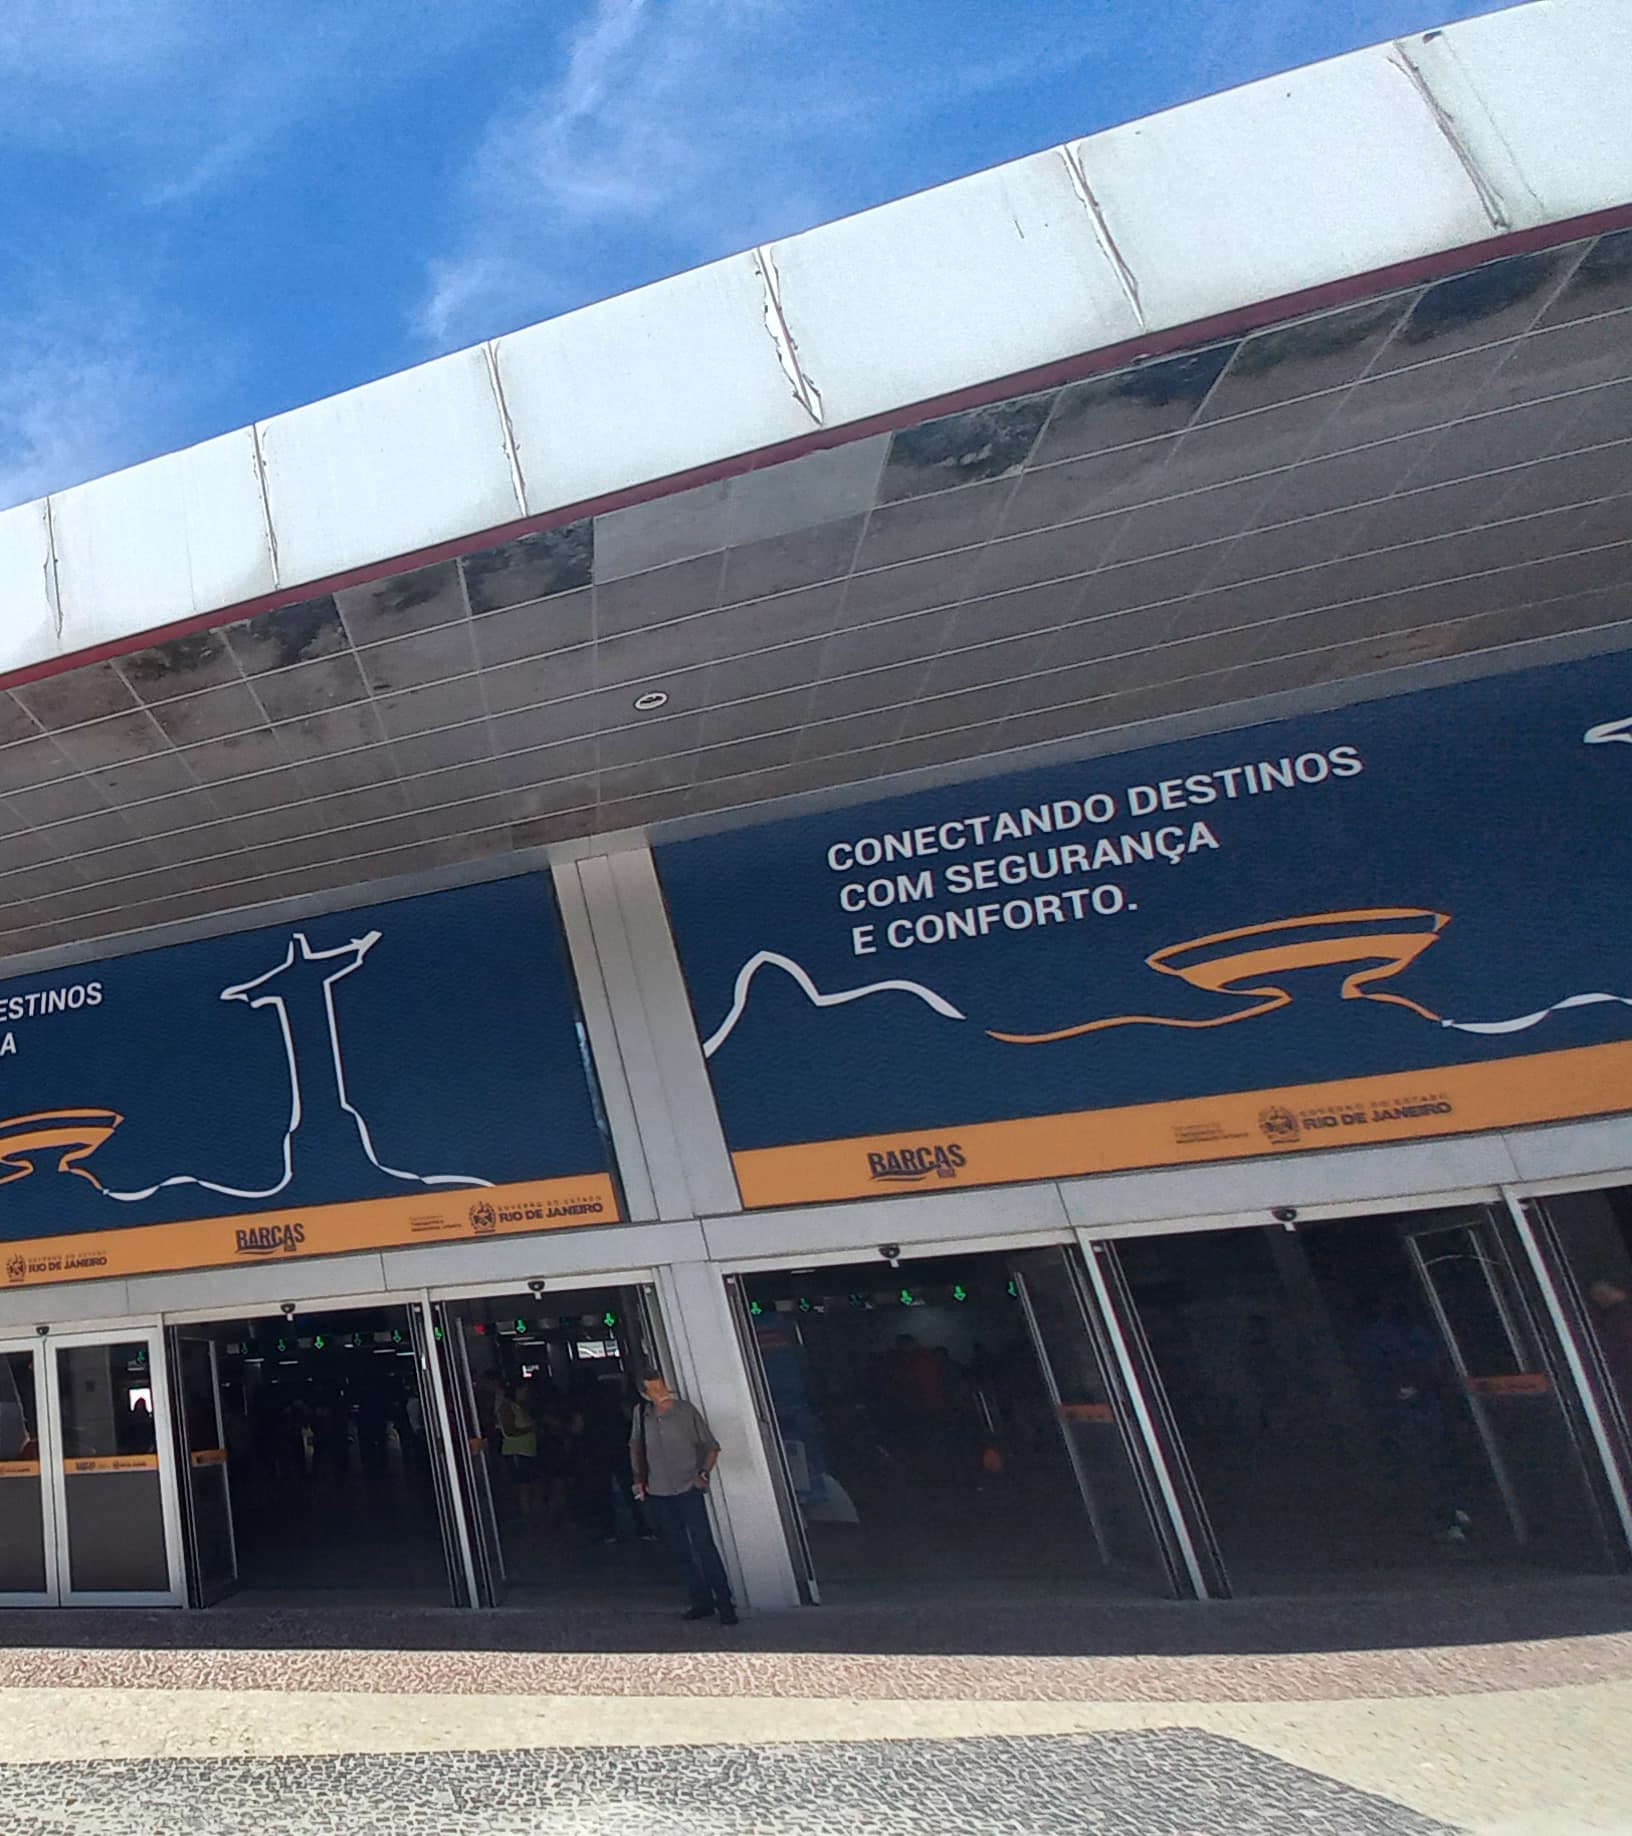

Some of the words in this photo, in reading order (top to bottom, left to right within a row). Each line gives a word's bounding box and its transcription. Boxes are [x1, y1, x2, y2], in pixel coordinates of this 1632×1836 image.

[827, 793, 1115, 871] CONECTANDO
[1126, 746, 1363, 817] DESTINOS
[839, 870, 934, 913] COM
[945, 821, 1218, 895] SEGURANÇA
[851, 925, 876, 955] E
[887, 883, 1138, 950] CONFORTO.
[1302, 1115, 1338, 1130] RIO
[1340, 1112, 1368, 1126] DE
[1371, 1101, 1452, 1122] JANEIRO
[867, 1144, 966, 1177] BARCAS
[498, 1211, 523, 1224] RIO
[525, 1209, 544, 1220] DE
[546, 1202, 604, 1218] JANEIRO
[235, 1223, 305, 1250] BARCAS
[48, 1261, 62, 1271] DE
